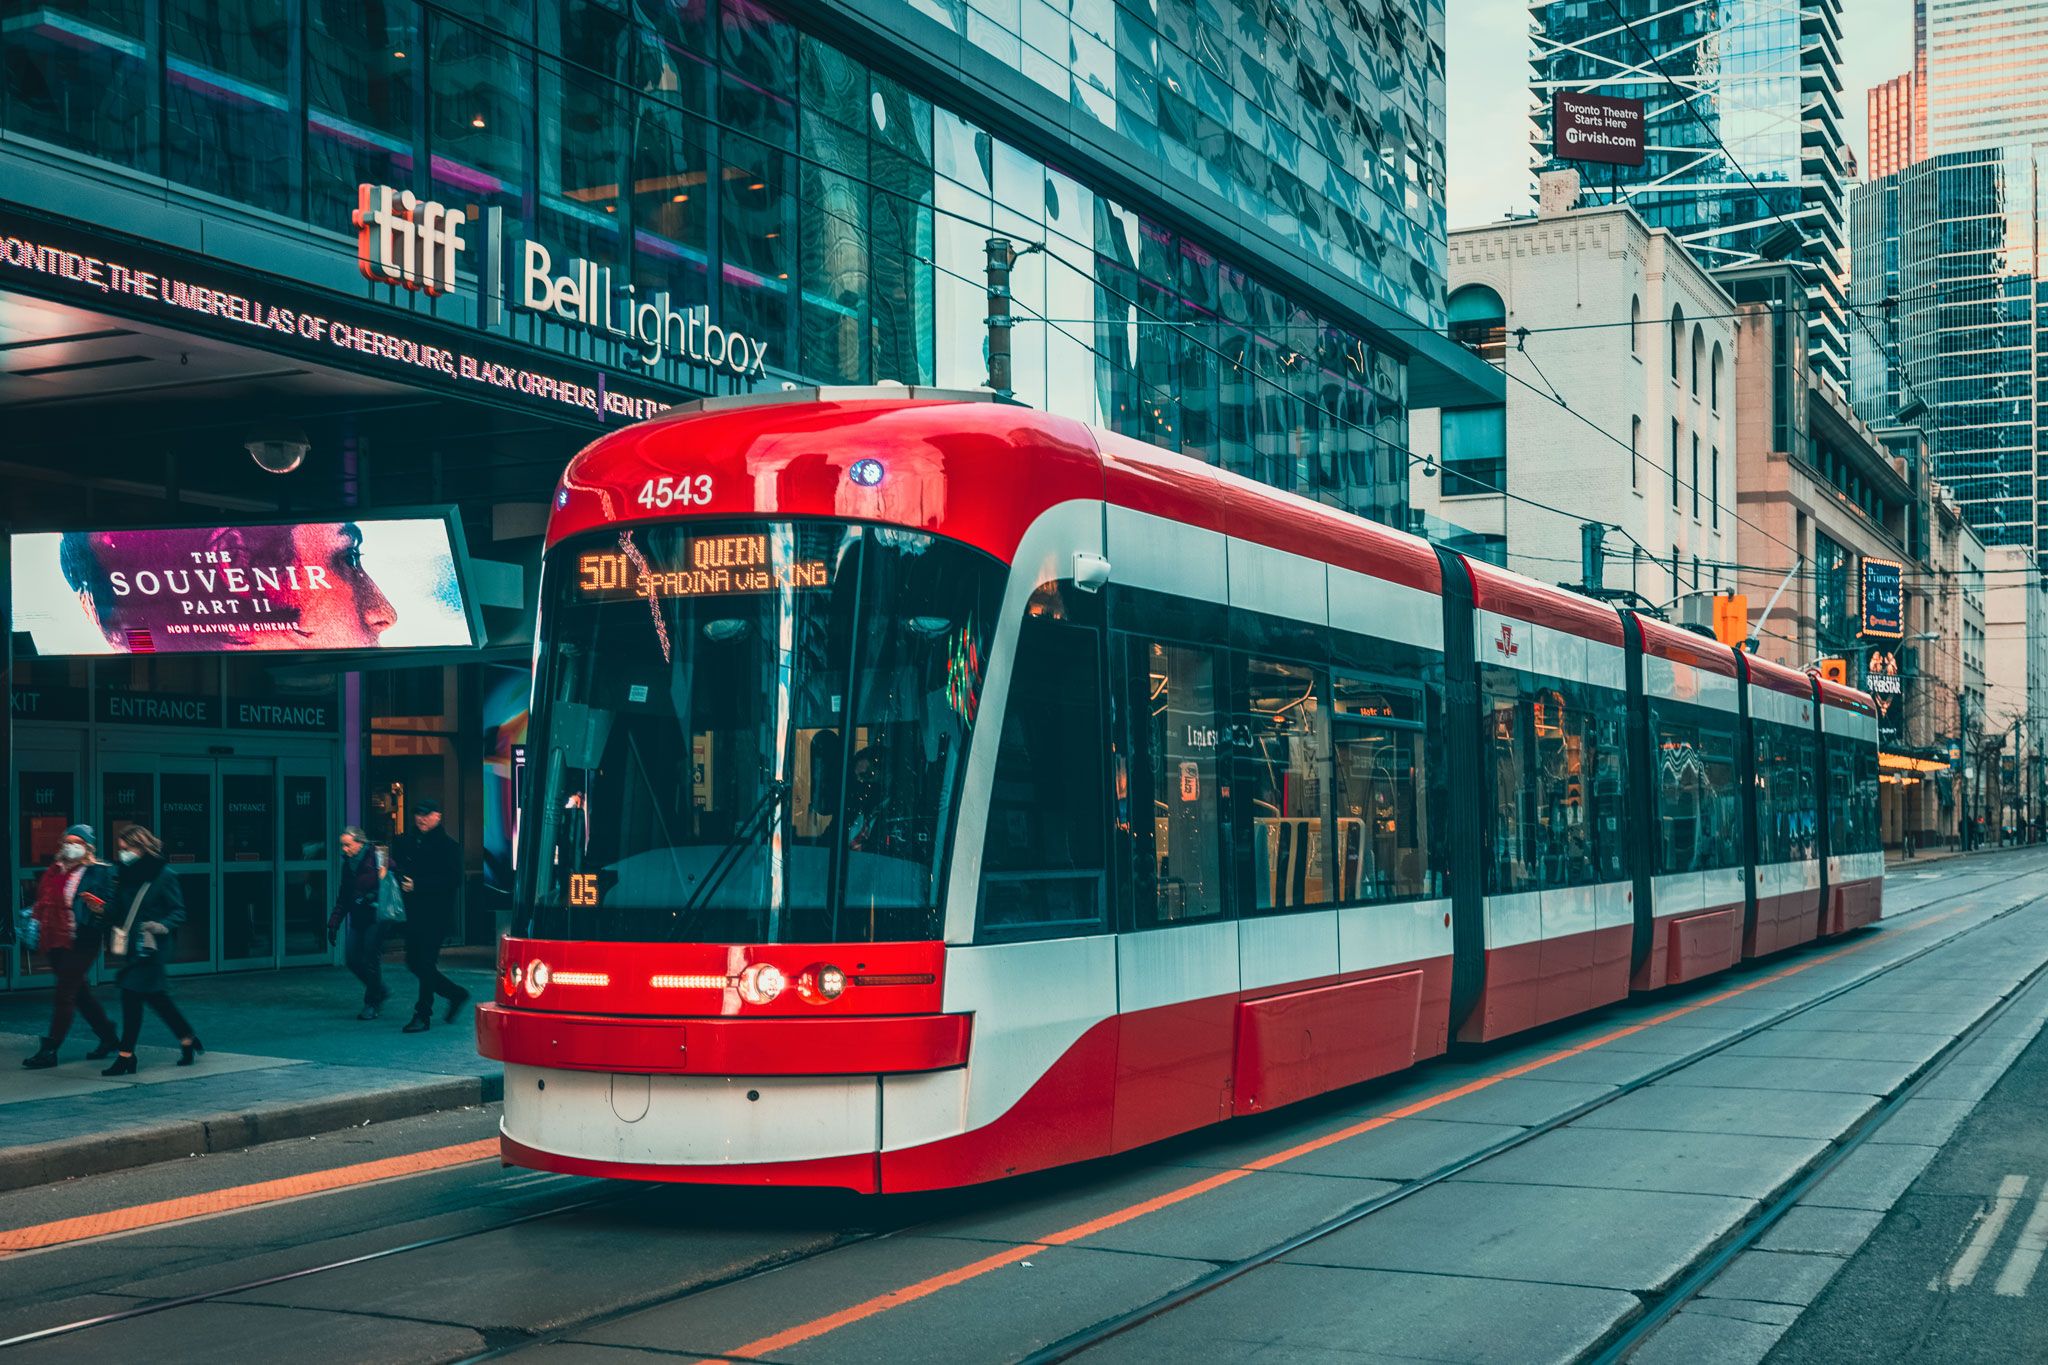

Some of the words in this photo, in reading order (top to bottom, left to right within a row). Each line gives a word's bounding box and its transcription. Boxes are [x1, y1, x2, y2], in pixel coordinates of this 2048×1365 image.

[1563, 101, 1600, 116] Toronto
[1602, 106, 1638, 120] Theatre
[1574, 114, 1602, 126] Starts
[1604, 118, 1627, 129] Here
[1565, 127, 1636, 147] mirvish.com
[354, 183, 466, 297] tiff
[524, 239, 598, 325] Bell
[605, 266, 768, 380] Lightbox
[106, 262, 159, 300] THE
[161, 276, 296, 335] UMBRELLAS
[298, 312, 329, 341] OF
[330, 321, 457, 379] CHERBOURG,
[459, 353, 517, 390] BLACK
[517, 370, 600, 414] ORPHEUS,
[638, 475, 713, 509] 4543
[191, 551, 232, 564] THE
[694, 536, 765, 567] QUEEN
[110, 565, 332, 597] SOUVENIR
[580, 554, 628, 591] 501
[635, 570, 729, 597] SPADINA
[736, 569, 770, 590] via
[774, 562, 828, 588] KING
[182, 599, 239, 615] PART
[253, 598, 272, 613] II
[166, 624, 190, 634] NOW
[193, 623, 236, 634] PLAYING
[238, 622, 250, 632] IN
[253, 621, 300, 632] CINEMAS
[12, 691, 41, 712] XIT
[110, 697, 206, 721] ENTRANCE
[240, 705, 326, 726] ENTRANCE
[36, 787, 55, 805] tiff
[296, 790, 311, 806] tiff
[162, 802, 203, 812] ENTRANCE
[228, 802, 267, 812] ENTRANCE
[570, 872, 598, 906] 05
